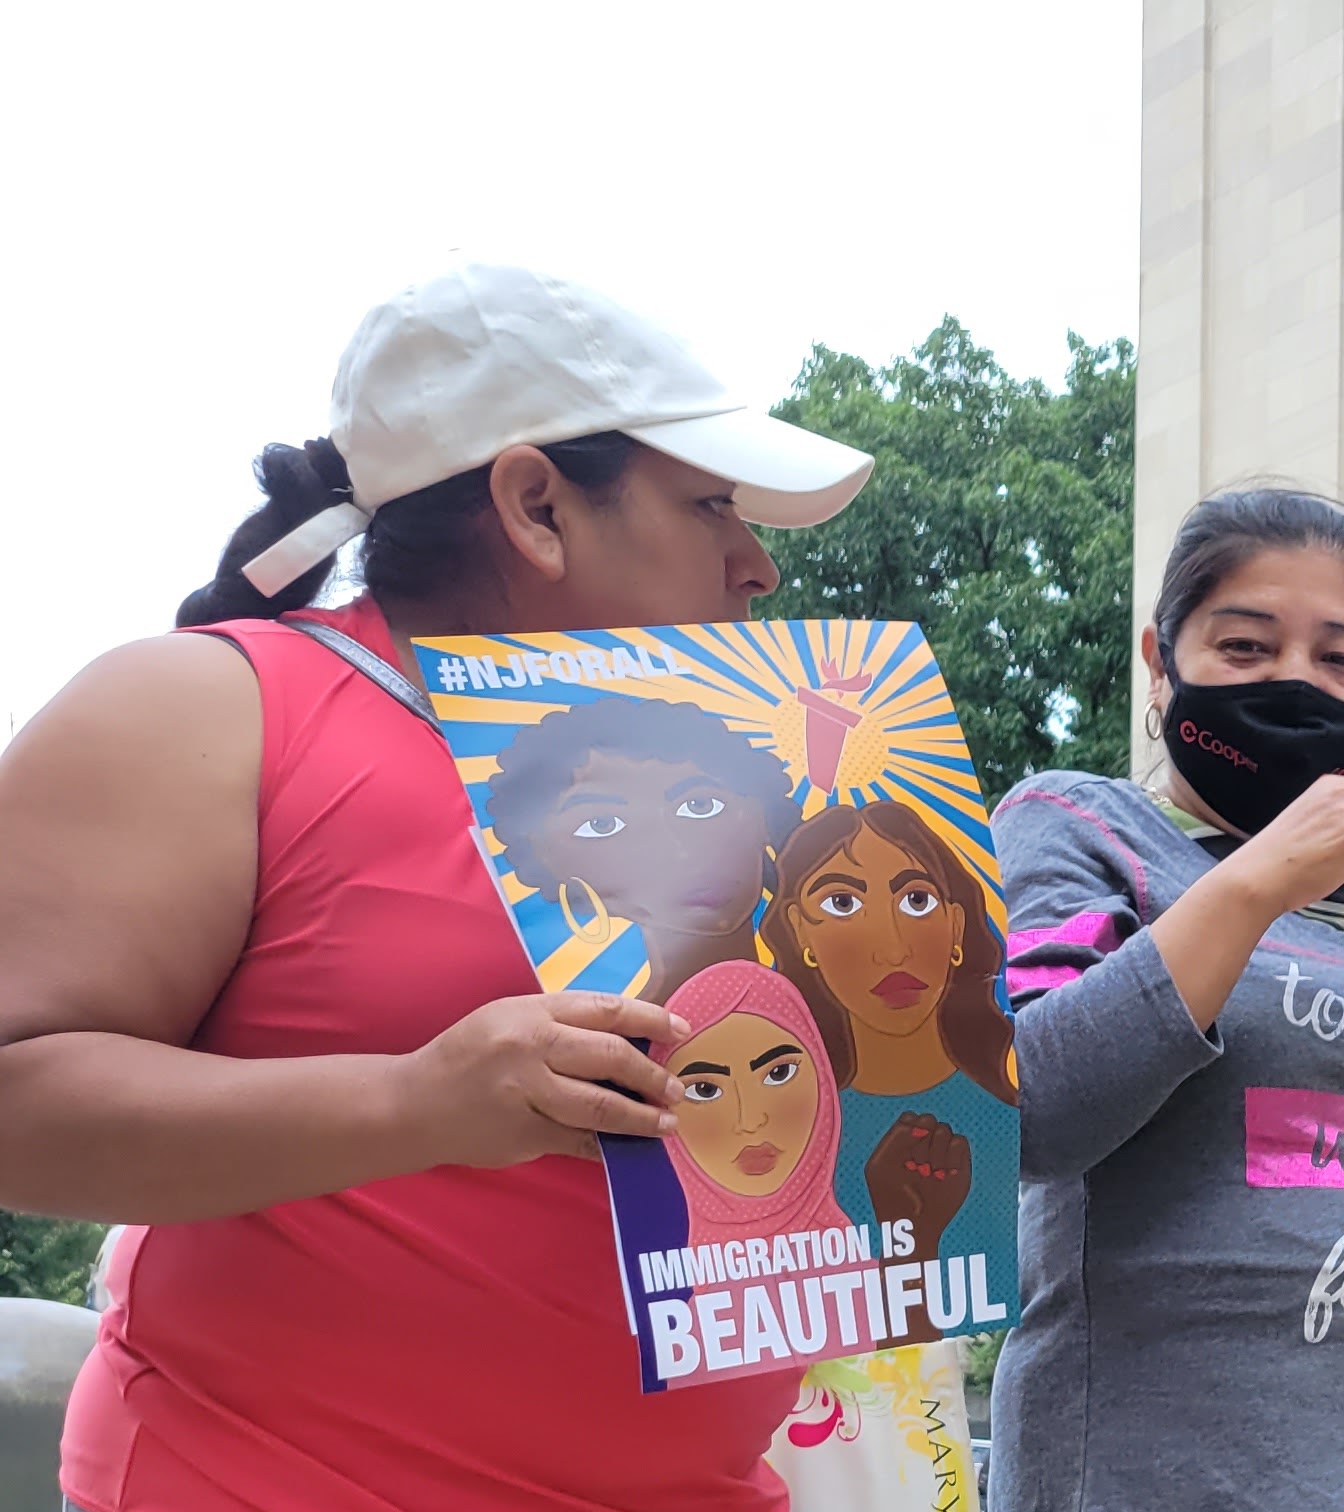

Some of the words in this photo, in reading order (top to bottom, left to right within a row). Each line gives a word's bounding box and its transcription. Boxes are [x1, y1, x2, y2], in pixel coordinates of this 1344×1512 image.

[437, 644, 692, 691] #NJFORALL
[638, 1223, 871, 1294] IMMIGRATION
[881, 1218, 916, 1257] IS
[648, 1253, 1007, 1381] BEAUTIFUL
